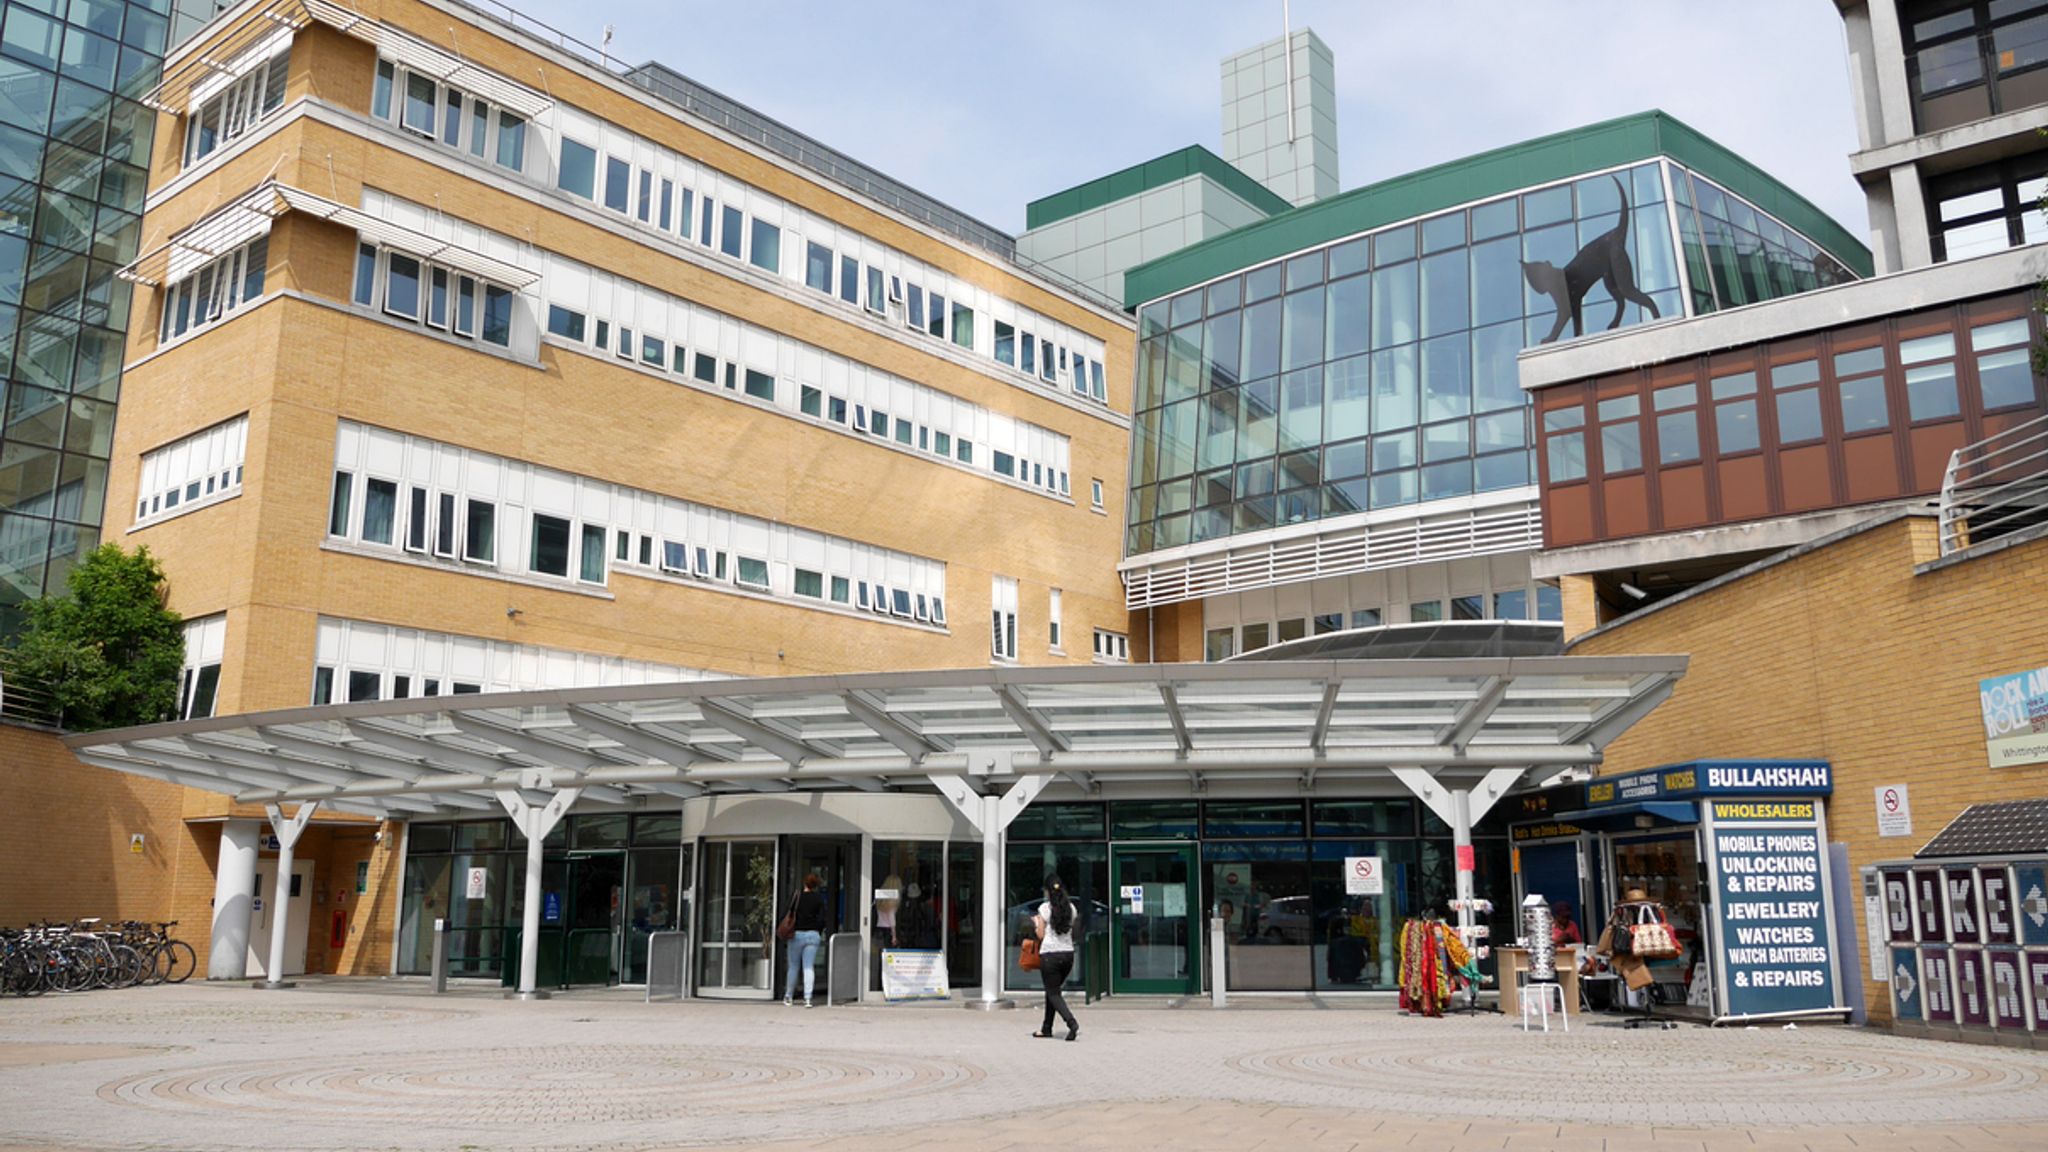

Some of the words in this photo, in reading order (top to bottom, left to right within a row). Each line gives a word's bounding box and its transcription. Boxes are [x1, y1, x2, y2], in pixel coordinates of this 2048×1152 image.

[1985, 701, 2029, 738] ROLL
[1664, 770, 1695, 790] WATCHES
[1708, 768, 1828, 787] BULLAHSHAH
[1715, 804, 1813, 818] WHOLESALERS
[1718, 836, 1765, 852] MOBILE
[1767, 835, 1816, 851] PHONES
[1722, 856, 1817, 873] UNLOCKING
[1727, 876, 1742, 892] &
[1744, 875, 1815, 892] REPAIRS
[1727, 902, 1819, 920] JEWELLERY
[1888, 878, 2009, 933] BIKE
[1737, 927, 1814, 944] WATCHES
[1728, 948, 1767, 964] WATCH
[1768, 947, 1827, 963] BATTERIES
[1735, 971, 1749, 987] &
[1752, 970, 1824, 987] REPAIRS
[1925, 958, 2048, 1020] HIRE
